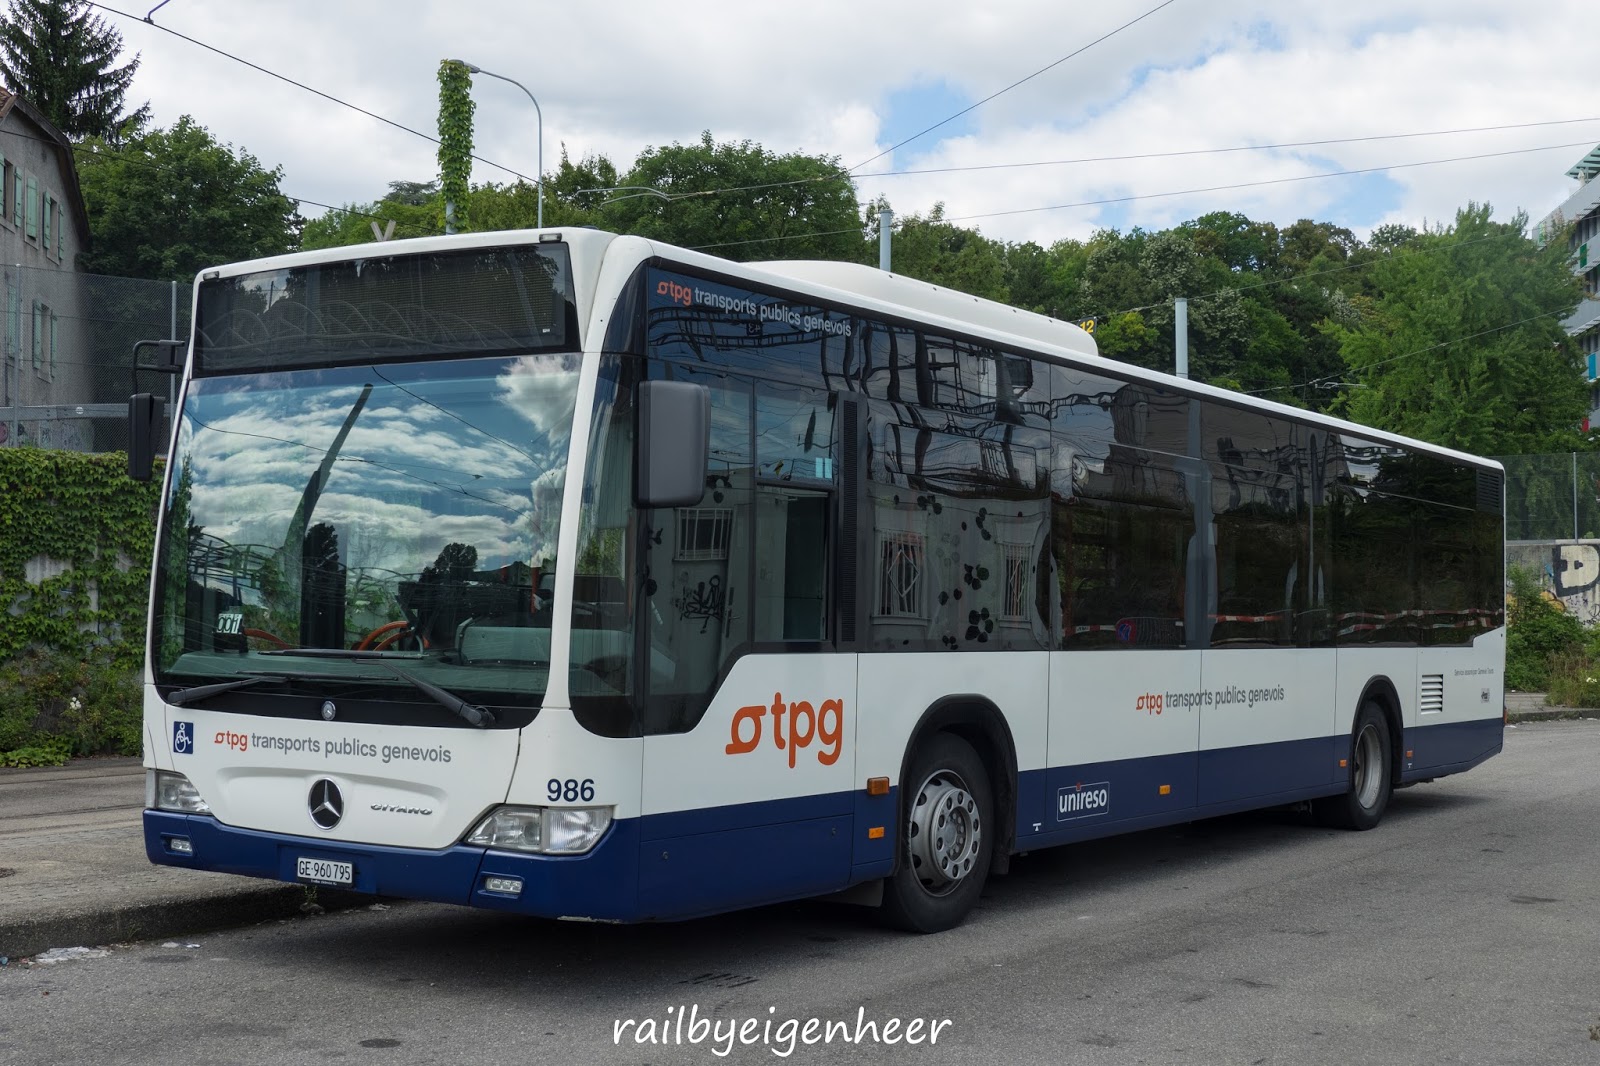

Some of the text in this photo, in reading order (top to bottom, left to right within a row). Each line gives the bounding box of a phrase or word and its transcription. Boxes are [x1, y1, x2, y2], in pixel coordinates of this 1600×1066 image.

[694, 287, 757, 316] transports
[760, 304, 801, 326] publics
[804, 314, 852, 337] genevois
[1166, 689, 1213, 712] transports
[1215, 685, 1247, 709] publics
[1248, 684, 1285, 708] genevois
[251, 733, 321, 755] transports
[325, 737, 378, 758] publics
[382, 745, 452, 763] genevois
[547, 778, 595, 802] 986
[1059, 784, 1108, 813] unireso
[370, 803, 433, 816] CITARO
